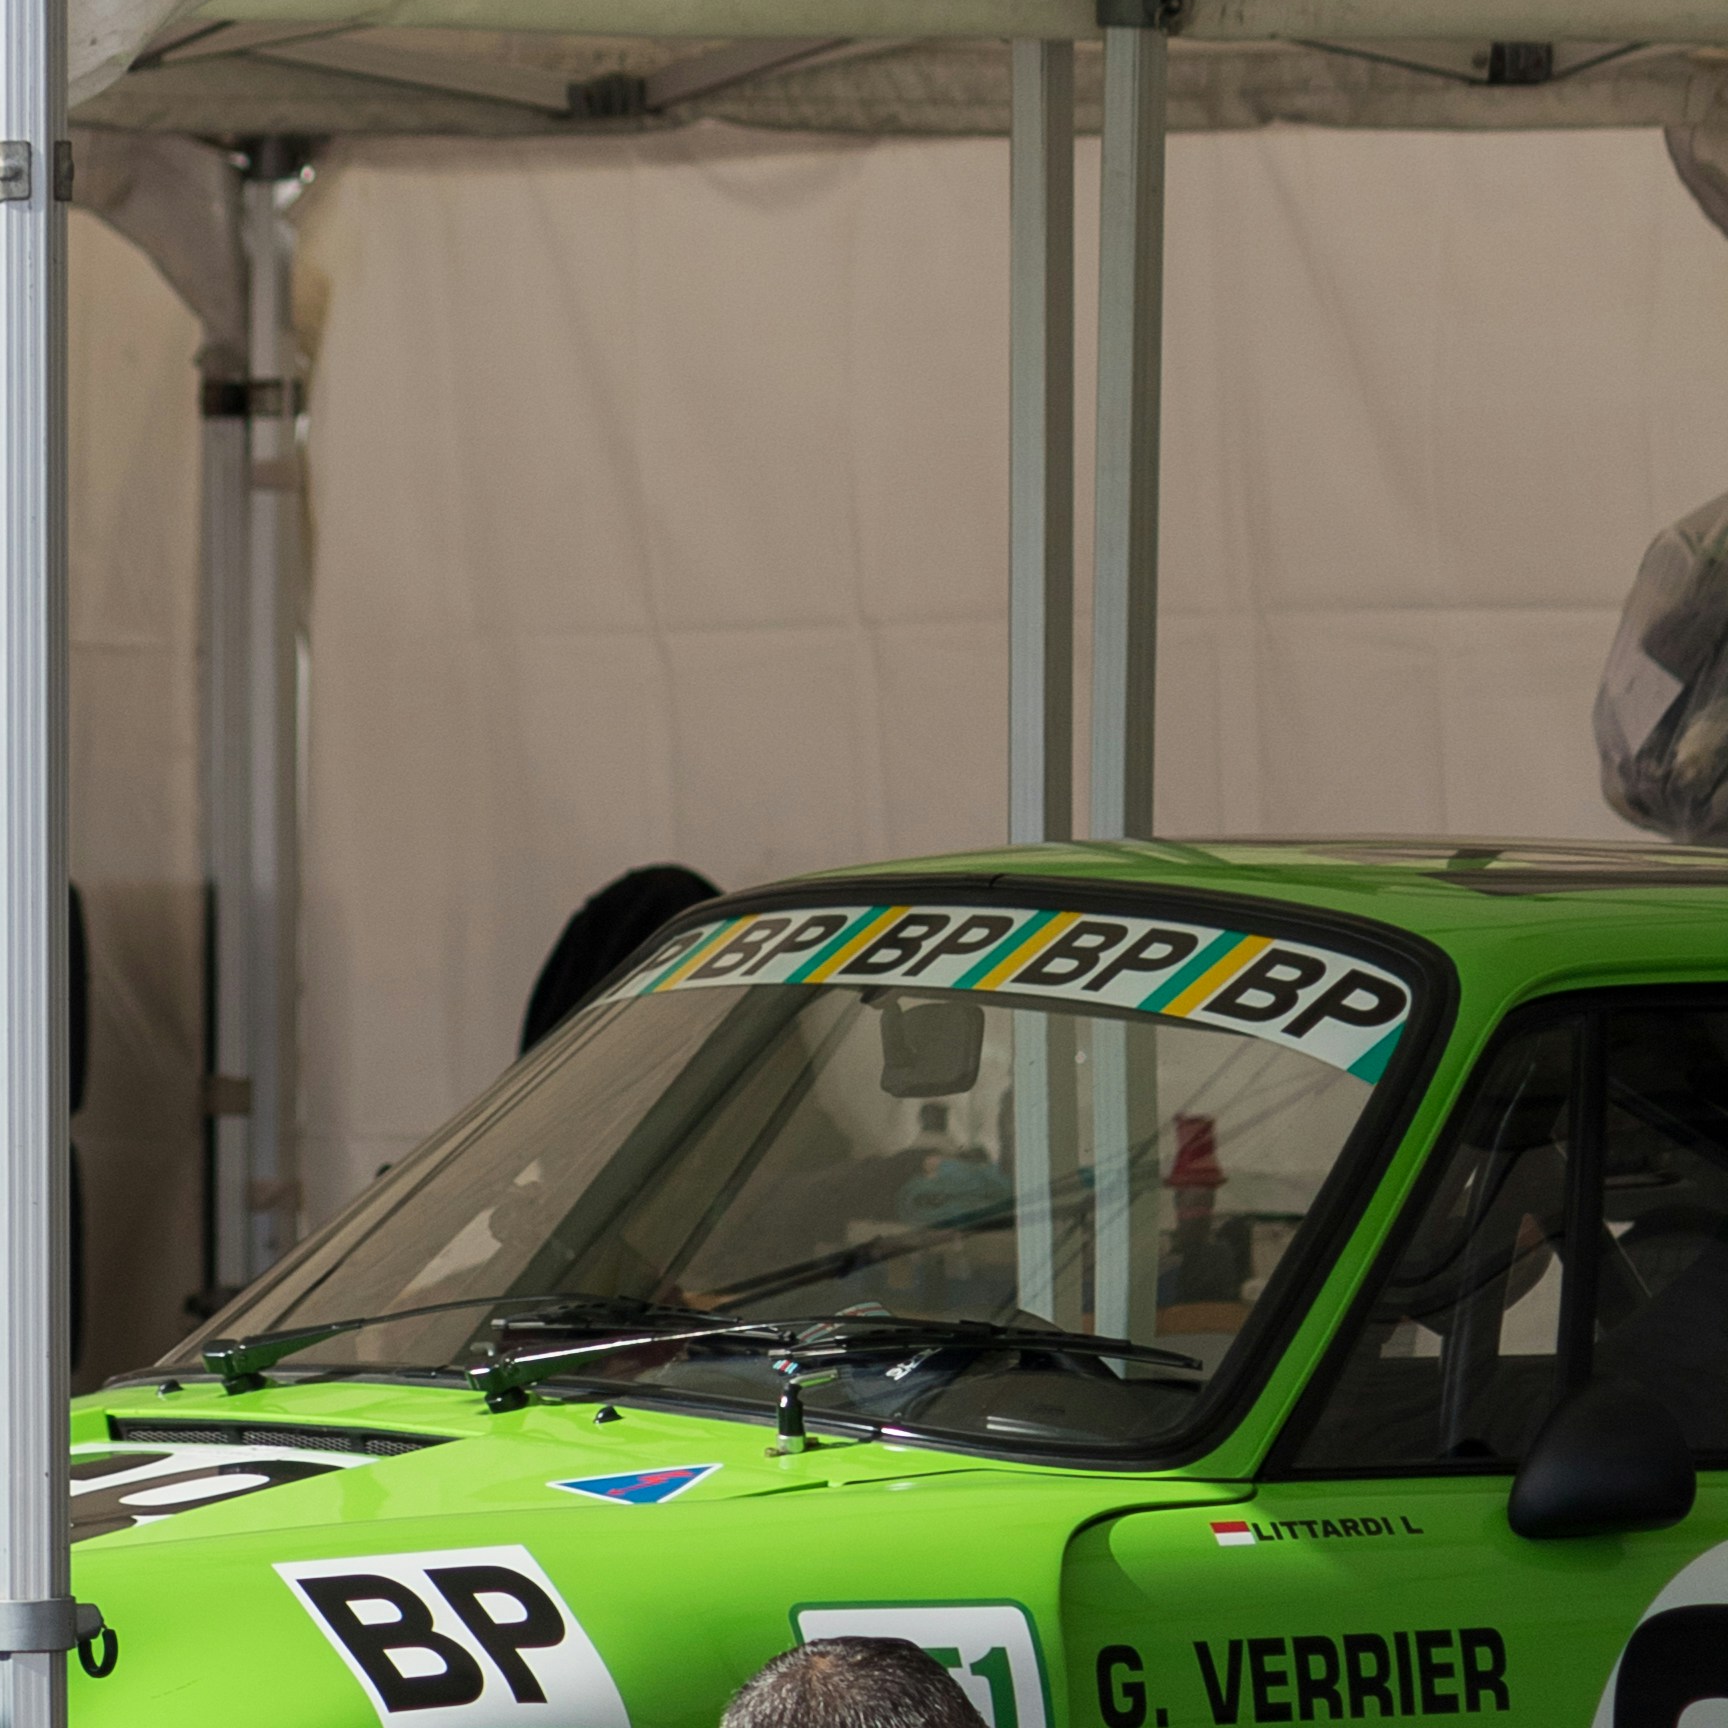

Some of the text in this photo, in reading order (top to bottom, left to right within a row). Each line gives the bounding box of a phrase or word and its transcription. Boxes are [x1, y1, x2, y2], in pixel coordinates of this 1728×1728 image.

[685, 914, 849, 981] BP
[837, 913, 1015, 978] BP
[1009, 920, 1199, 993] BP
[1201, 947, 1408, 1039] BP
[1252, 1515, 1424, 1542] LITTARDI L
[297, 1564, 566, 1714] BP
[1193, 1627, 1511, 1726] VERRIER
